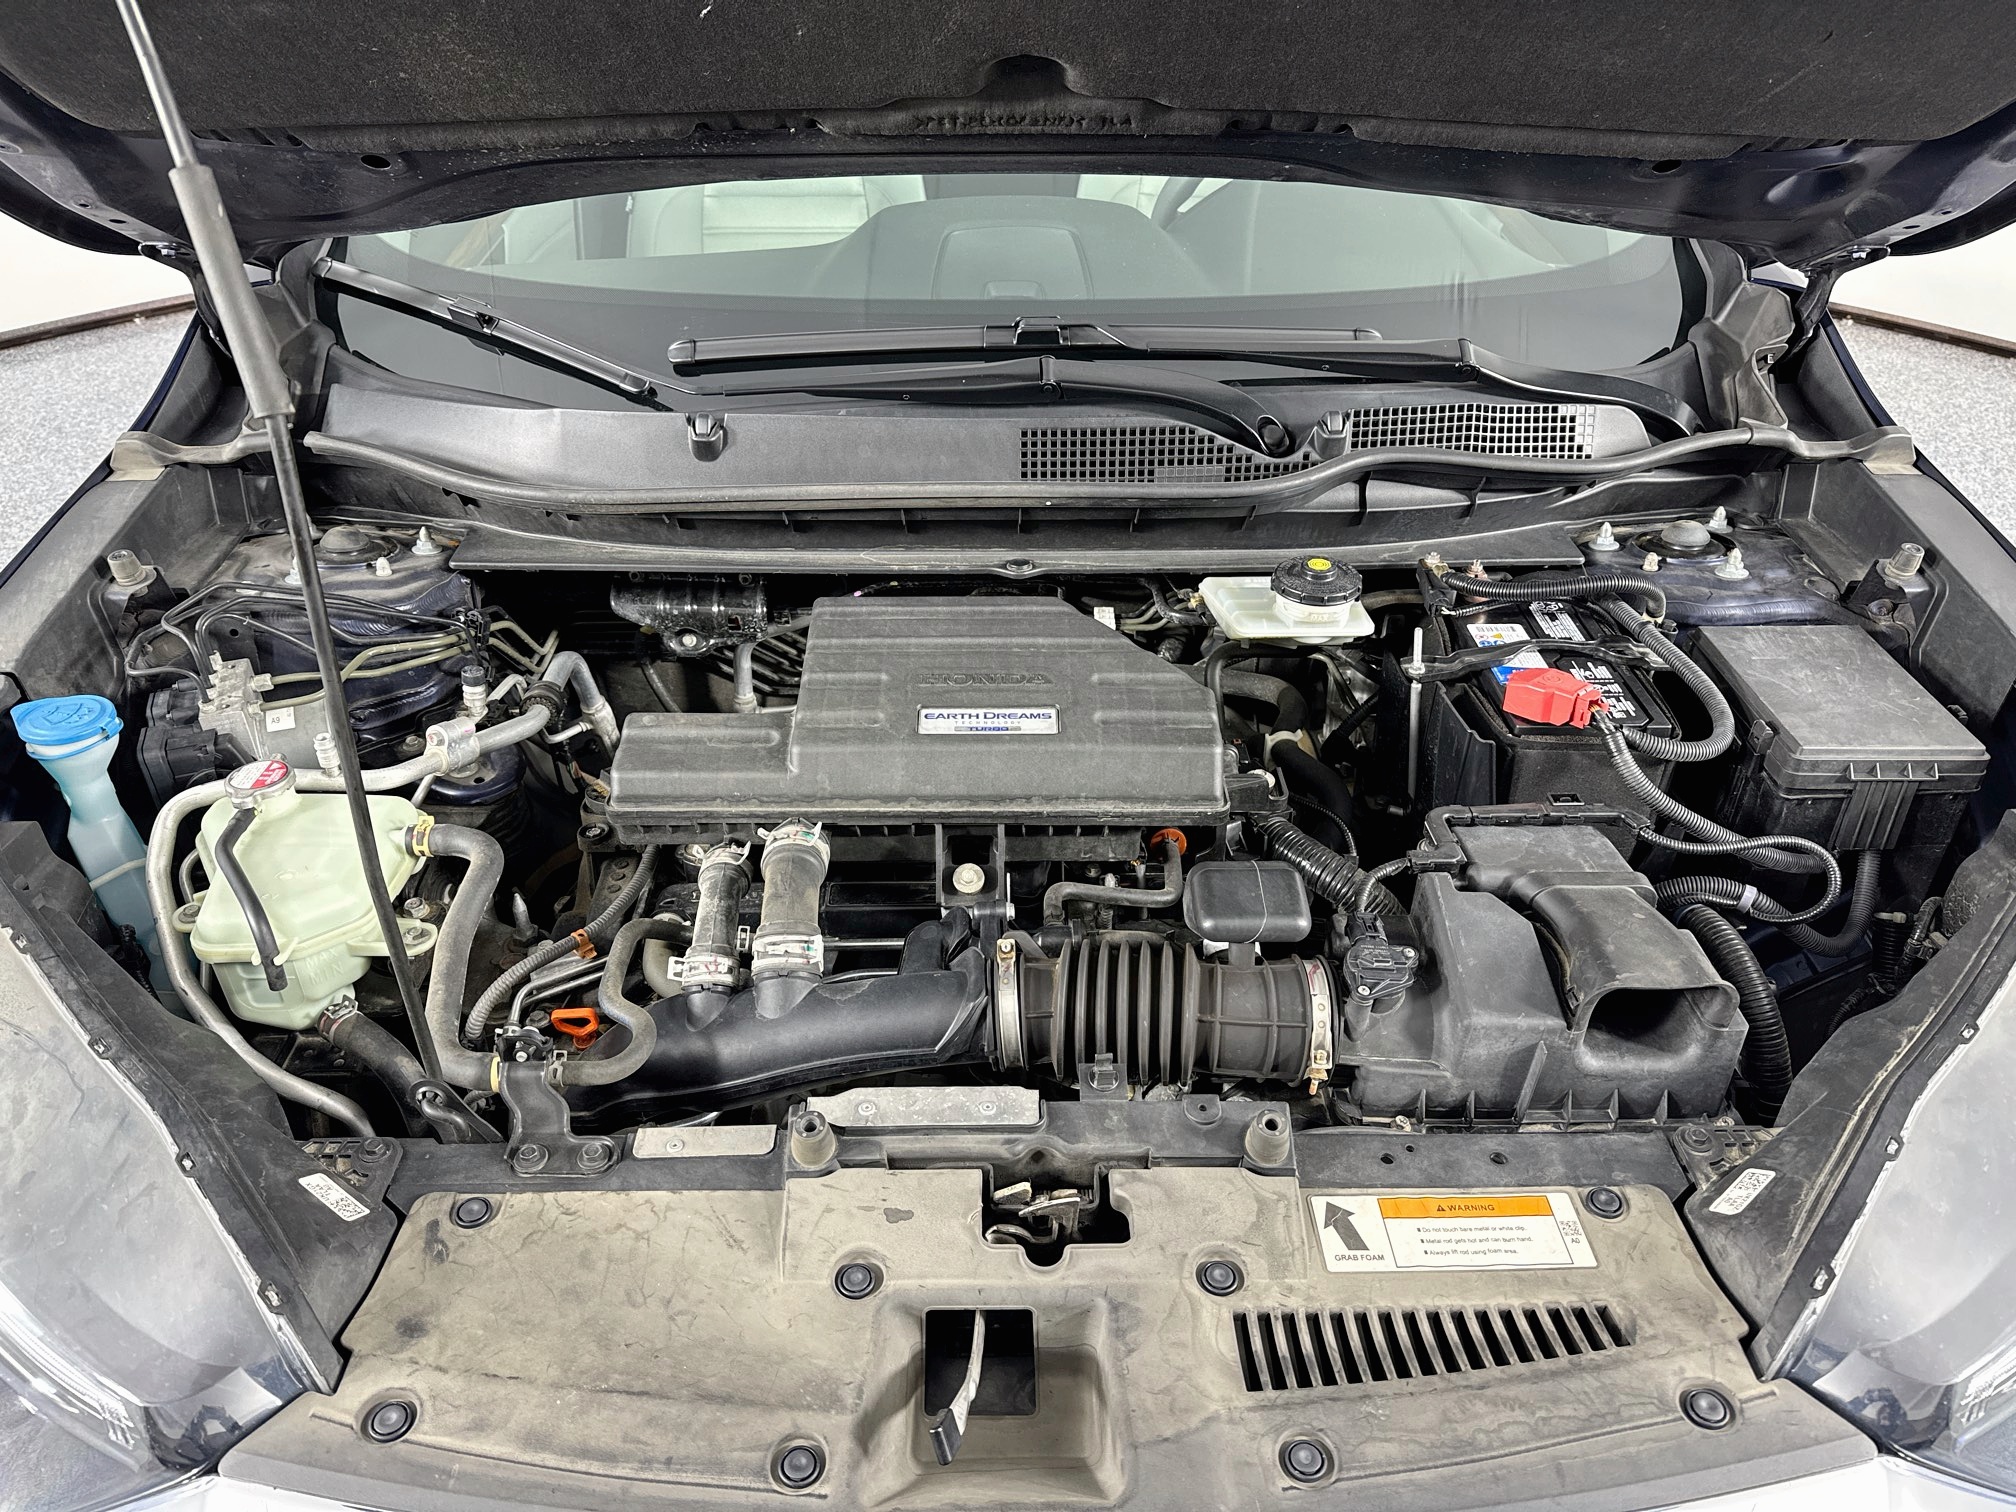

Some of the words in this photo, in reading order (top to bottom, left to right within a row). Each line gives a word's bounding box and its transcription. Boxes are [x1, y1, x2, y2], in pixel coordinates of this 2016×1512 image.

[918, 672, 1055, 687] HONDA
[924, 711, 980, 720] EARTH
[304, 948, 338, 971] MAX
[309, 961, 345, 985] MIN
[1447, 1204, 1496, 1212] WARNING
[1334, 1254, 1359, 1262] GRAB
[1360, 1253, 1386, 1261] FOAM
